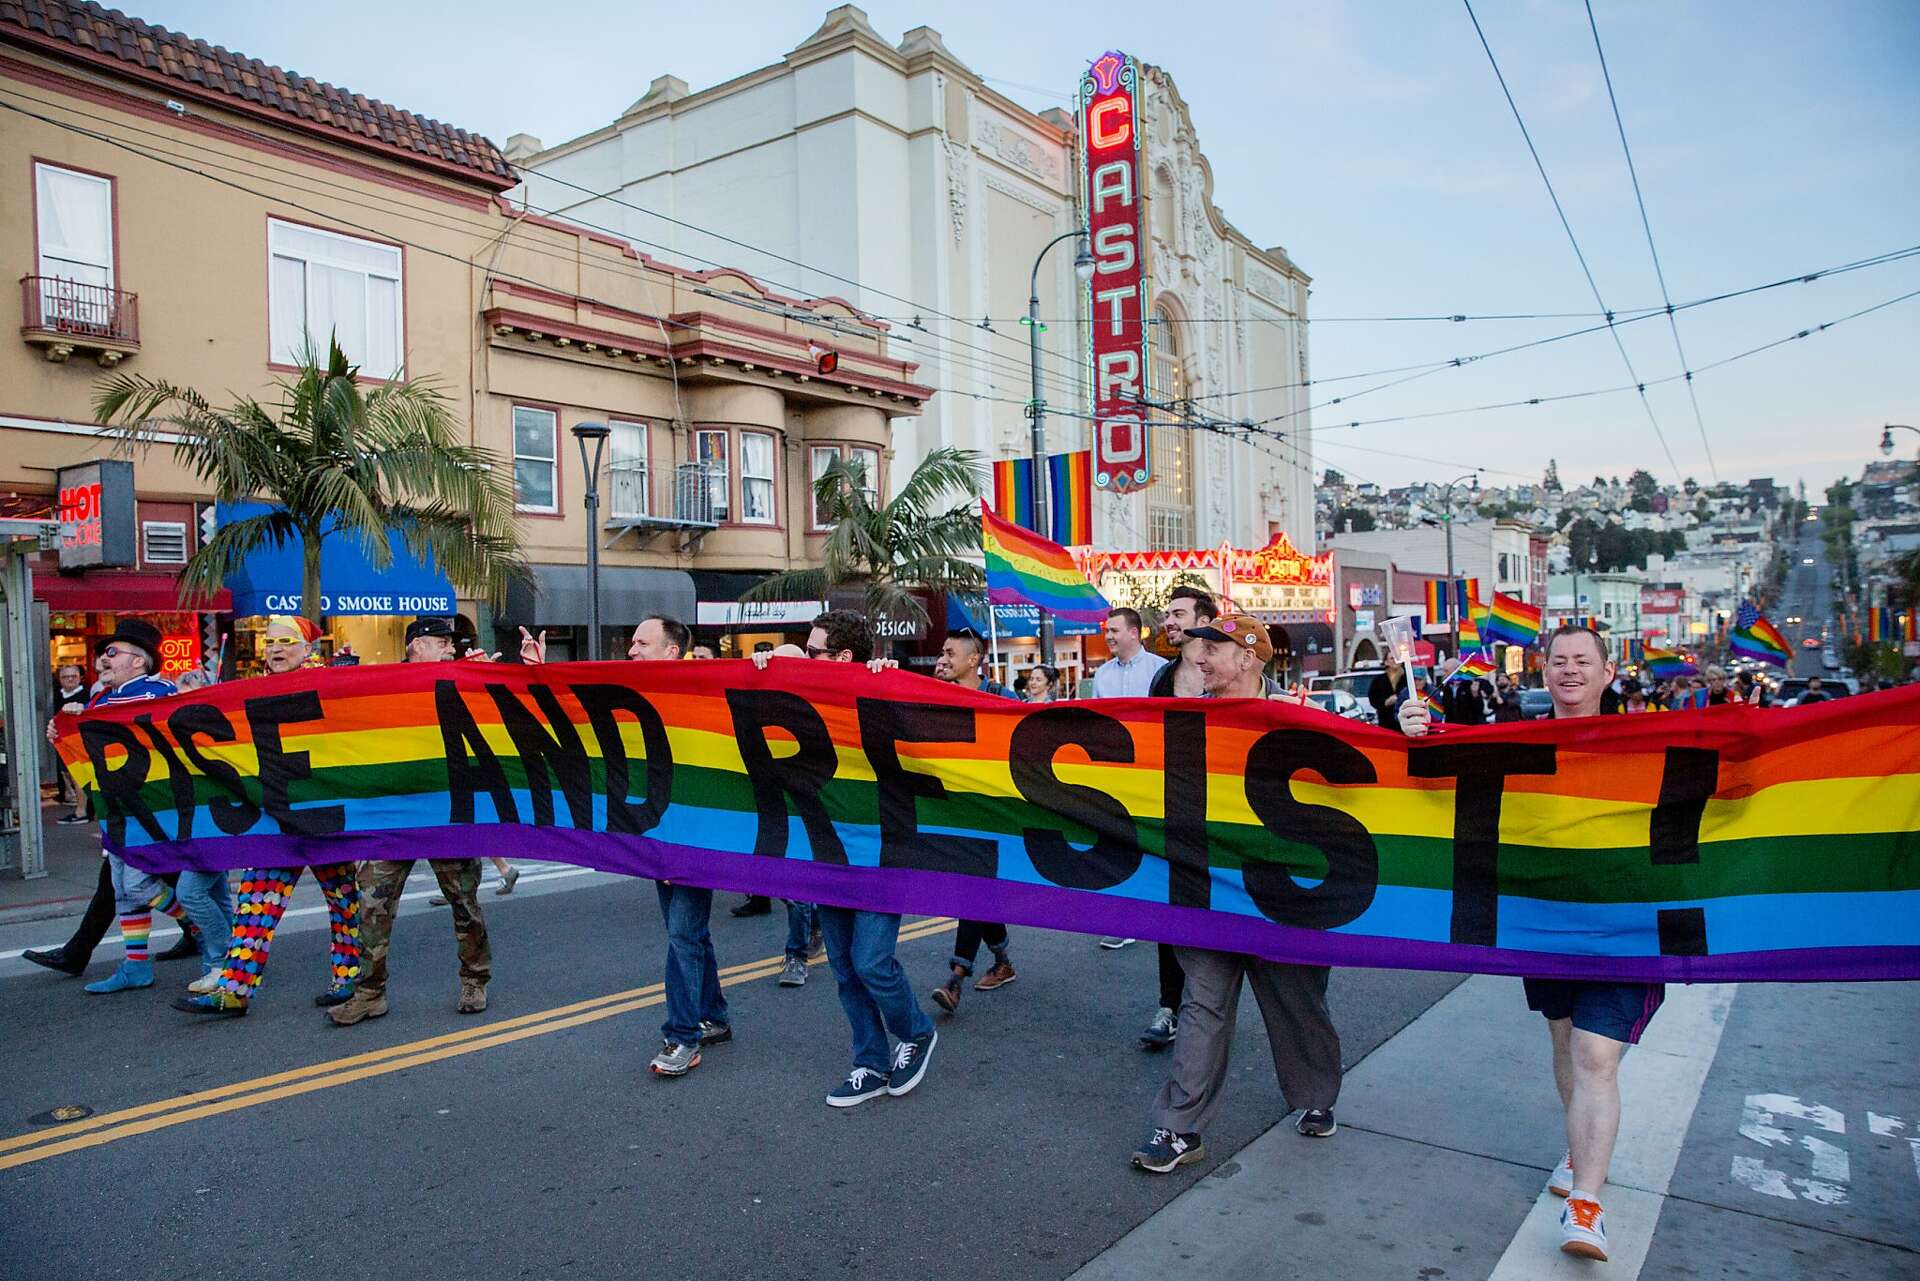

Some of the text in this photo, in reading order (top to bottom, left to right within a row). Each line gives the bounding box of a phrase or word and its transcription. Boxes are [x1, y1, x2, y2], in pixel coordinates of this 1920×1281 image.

[1088, 96, 1144, 465] CASTRO
[60, 483, 102, 523] HOT
[265, 594, 449, 612] CASTO SMOKE HOUSE
[160, 639, 192, 658] OT
[79, 680, 1719, 957] RISE AND RESIST!
